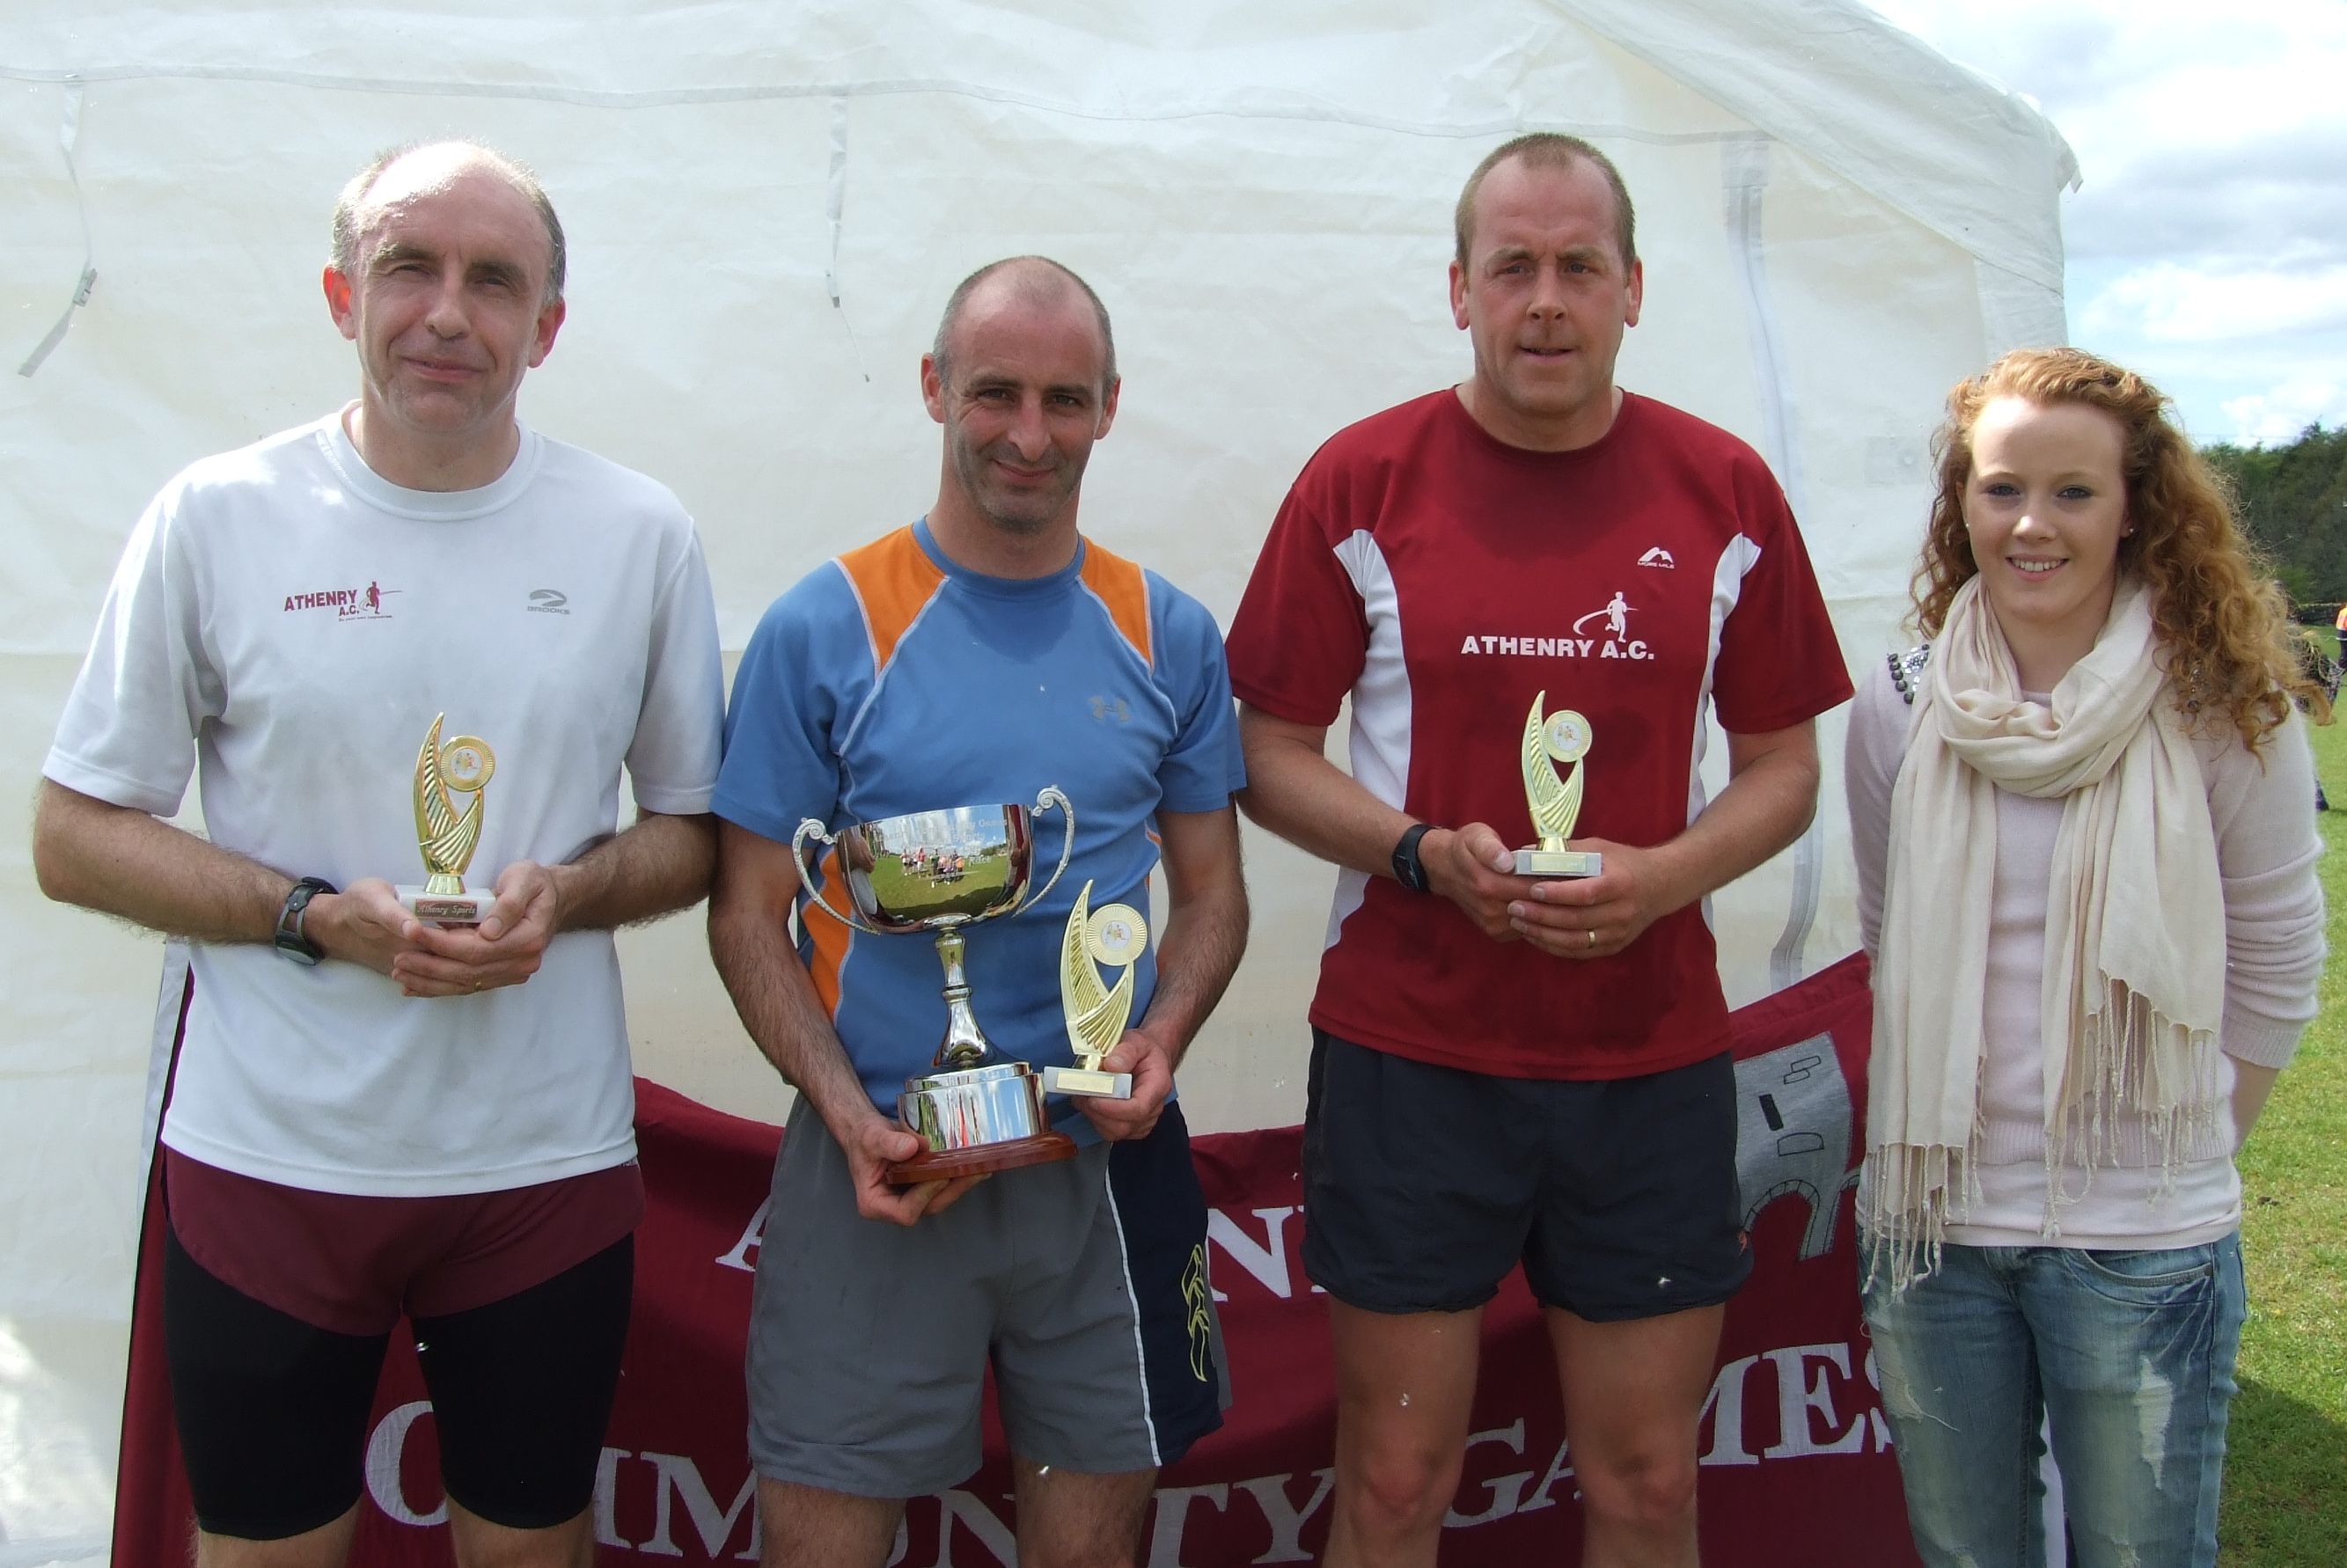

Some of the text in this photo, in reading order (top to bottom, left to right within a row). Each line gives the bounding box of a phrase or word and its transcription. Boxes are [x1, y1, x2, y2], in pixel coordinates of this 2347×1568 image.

[284, 590, 357, 612] ATHENRY
[339, 604, 359, 617] A.C.
[527, 606, 570, 615] BROOKS
[1461, 635, 1654, 660] ATHENRY A.C.
